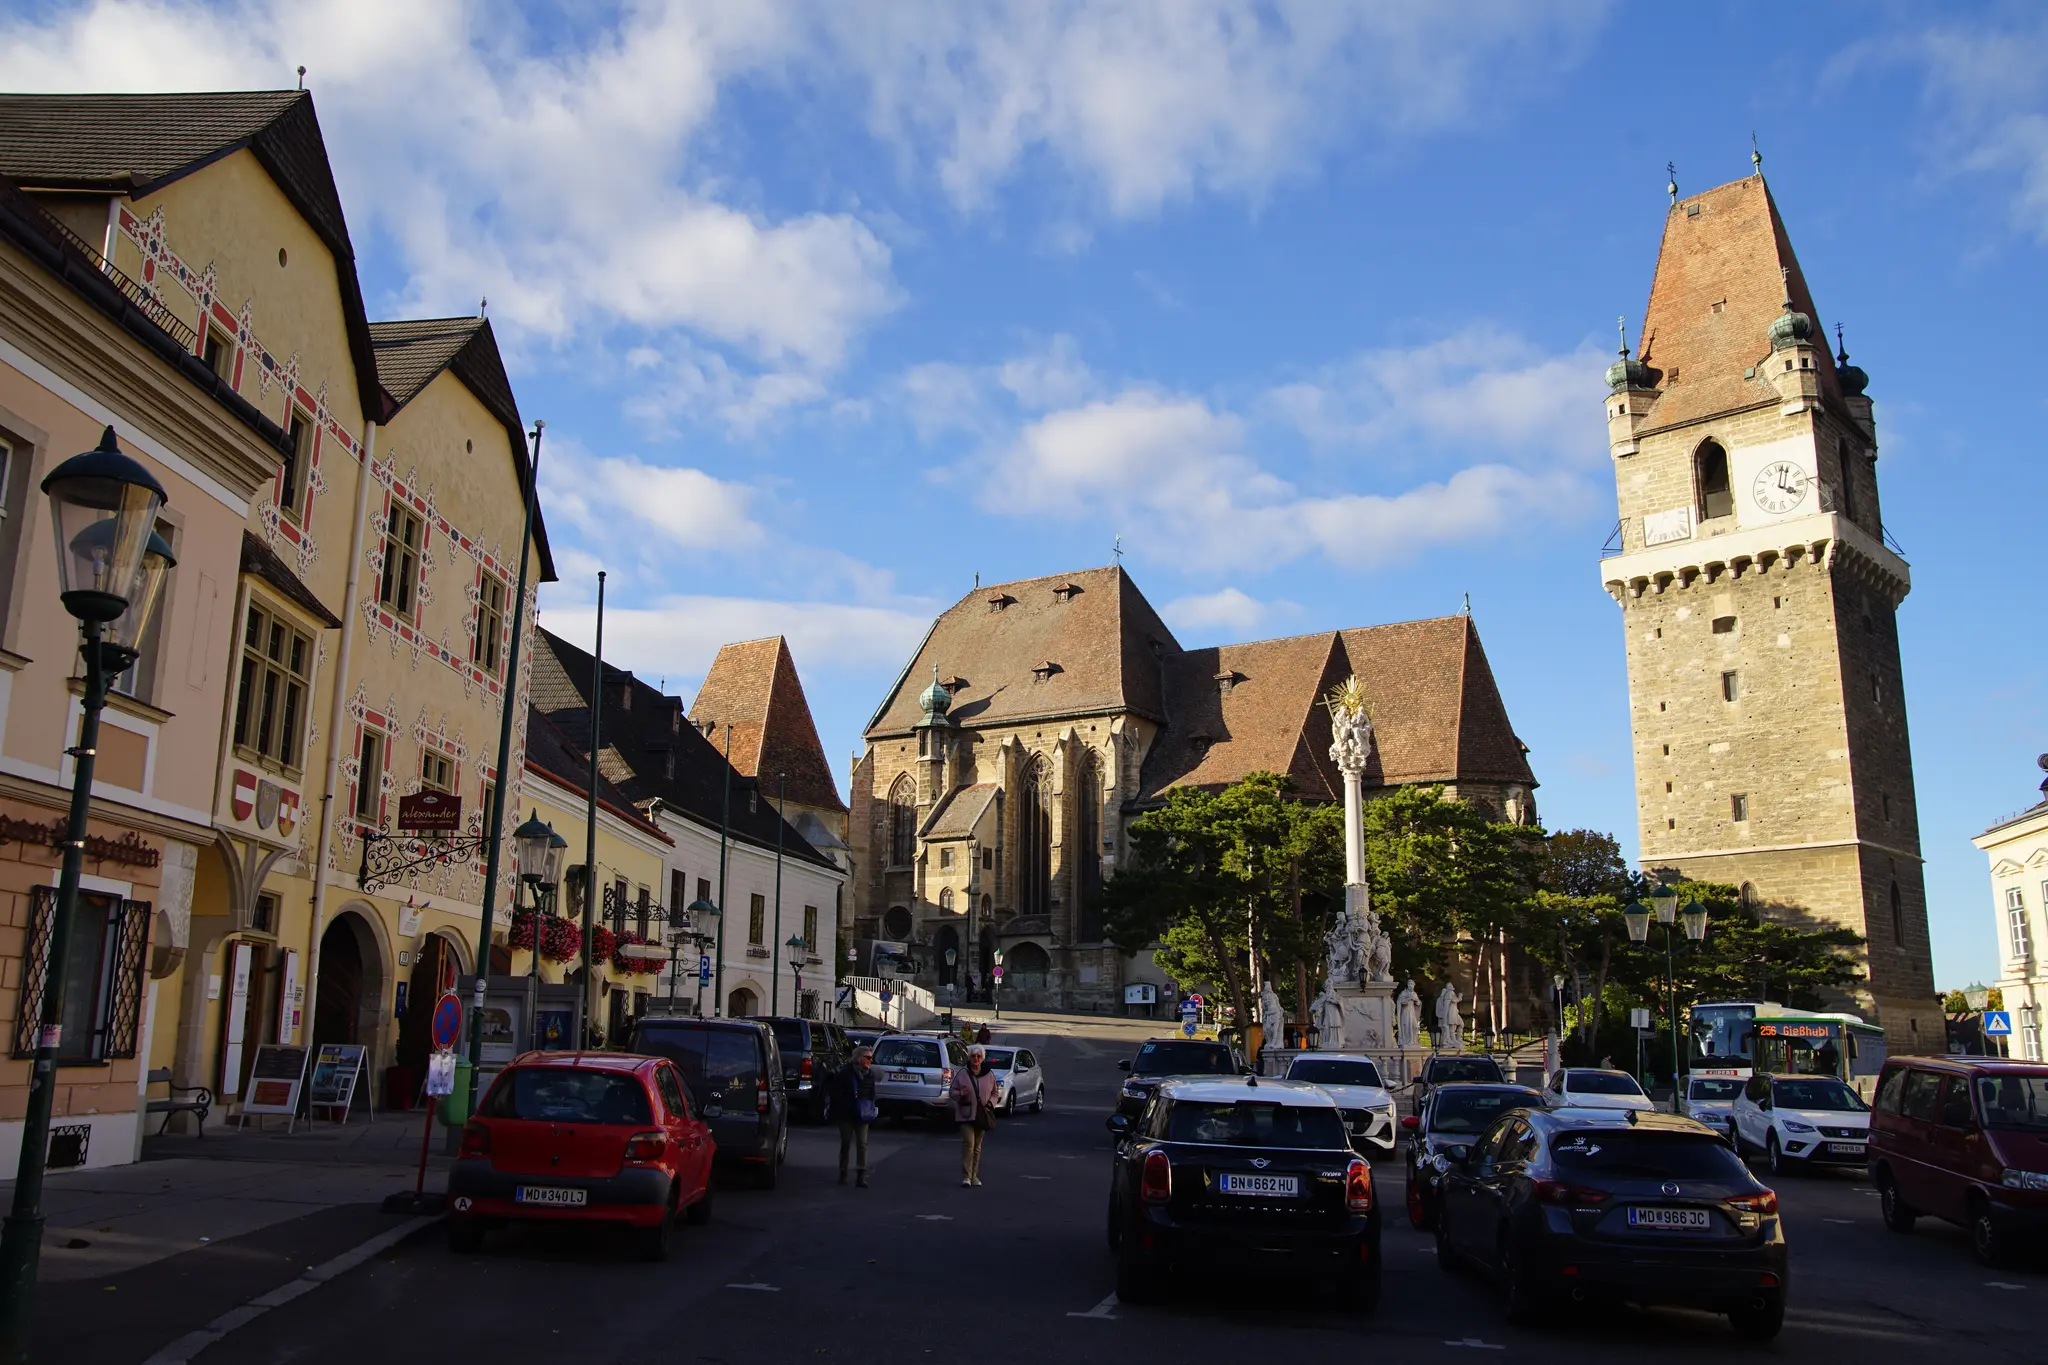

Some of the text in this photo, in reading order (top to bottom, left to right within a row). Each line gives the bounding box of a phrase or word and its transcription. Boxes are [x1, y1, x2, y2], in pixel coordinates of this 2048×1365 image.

[401, 805, 457, 819] alexander
[701, 957, 709, 978] P
[1760, 1025, 1777, 1036] 256
[1254, 1178, 1276, 1191] 662
[548, 1190, 569, 1202] 340
[1664, 1210, 1687, 1224] 966
